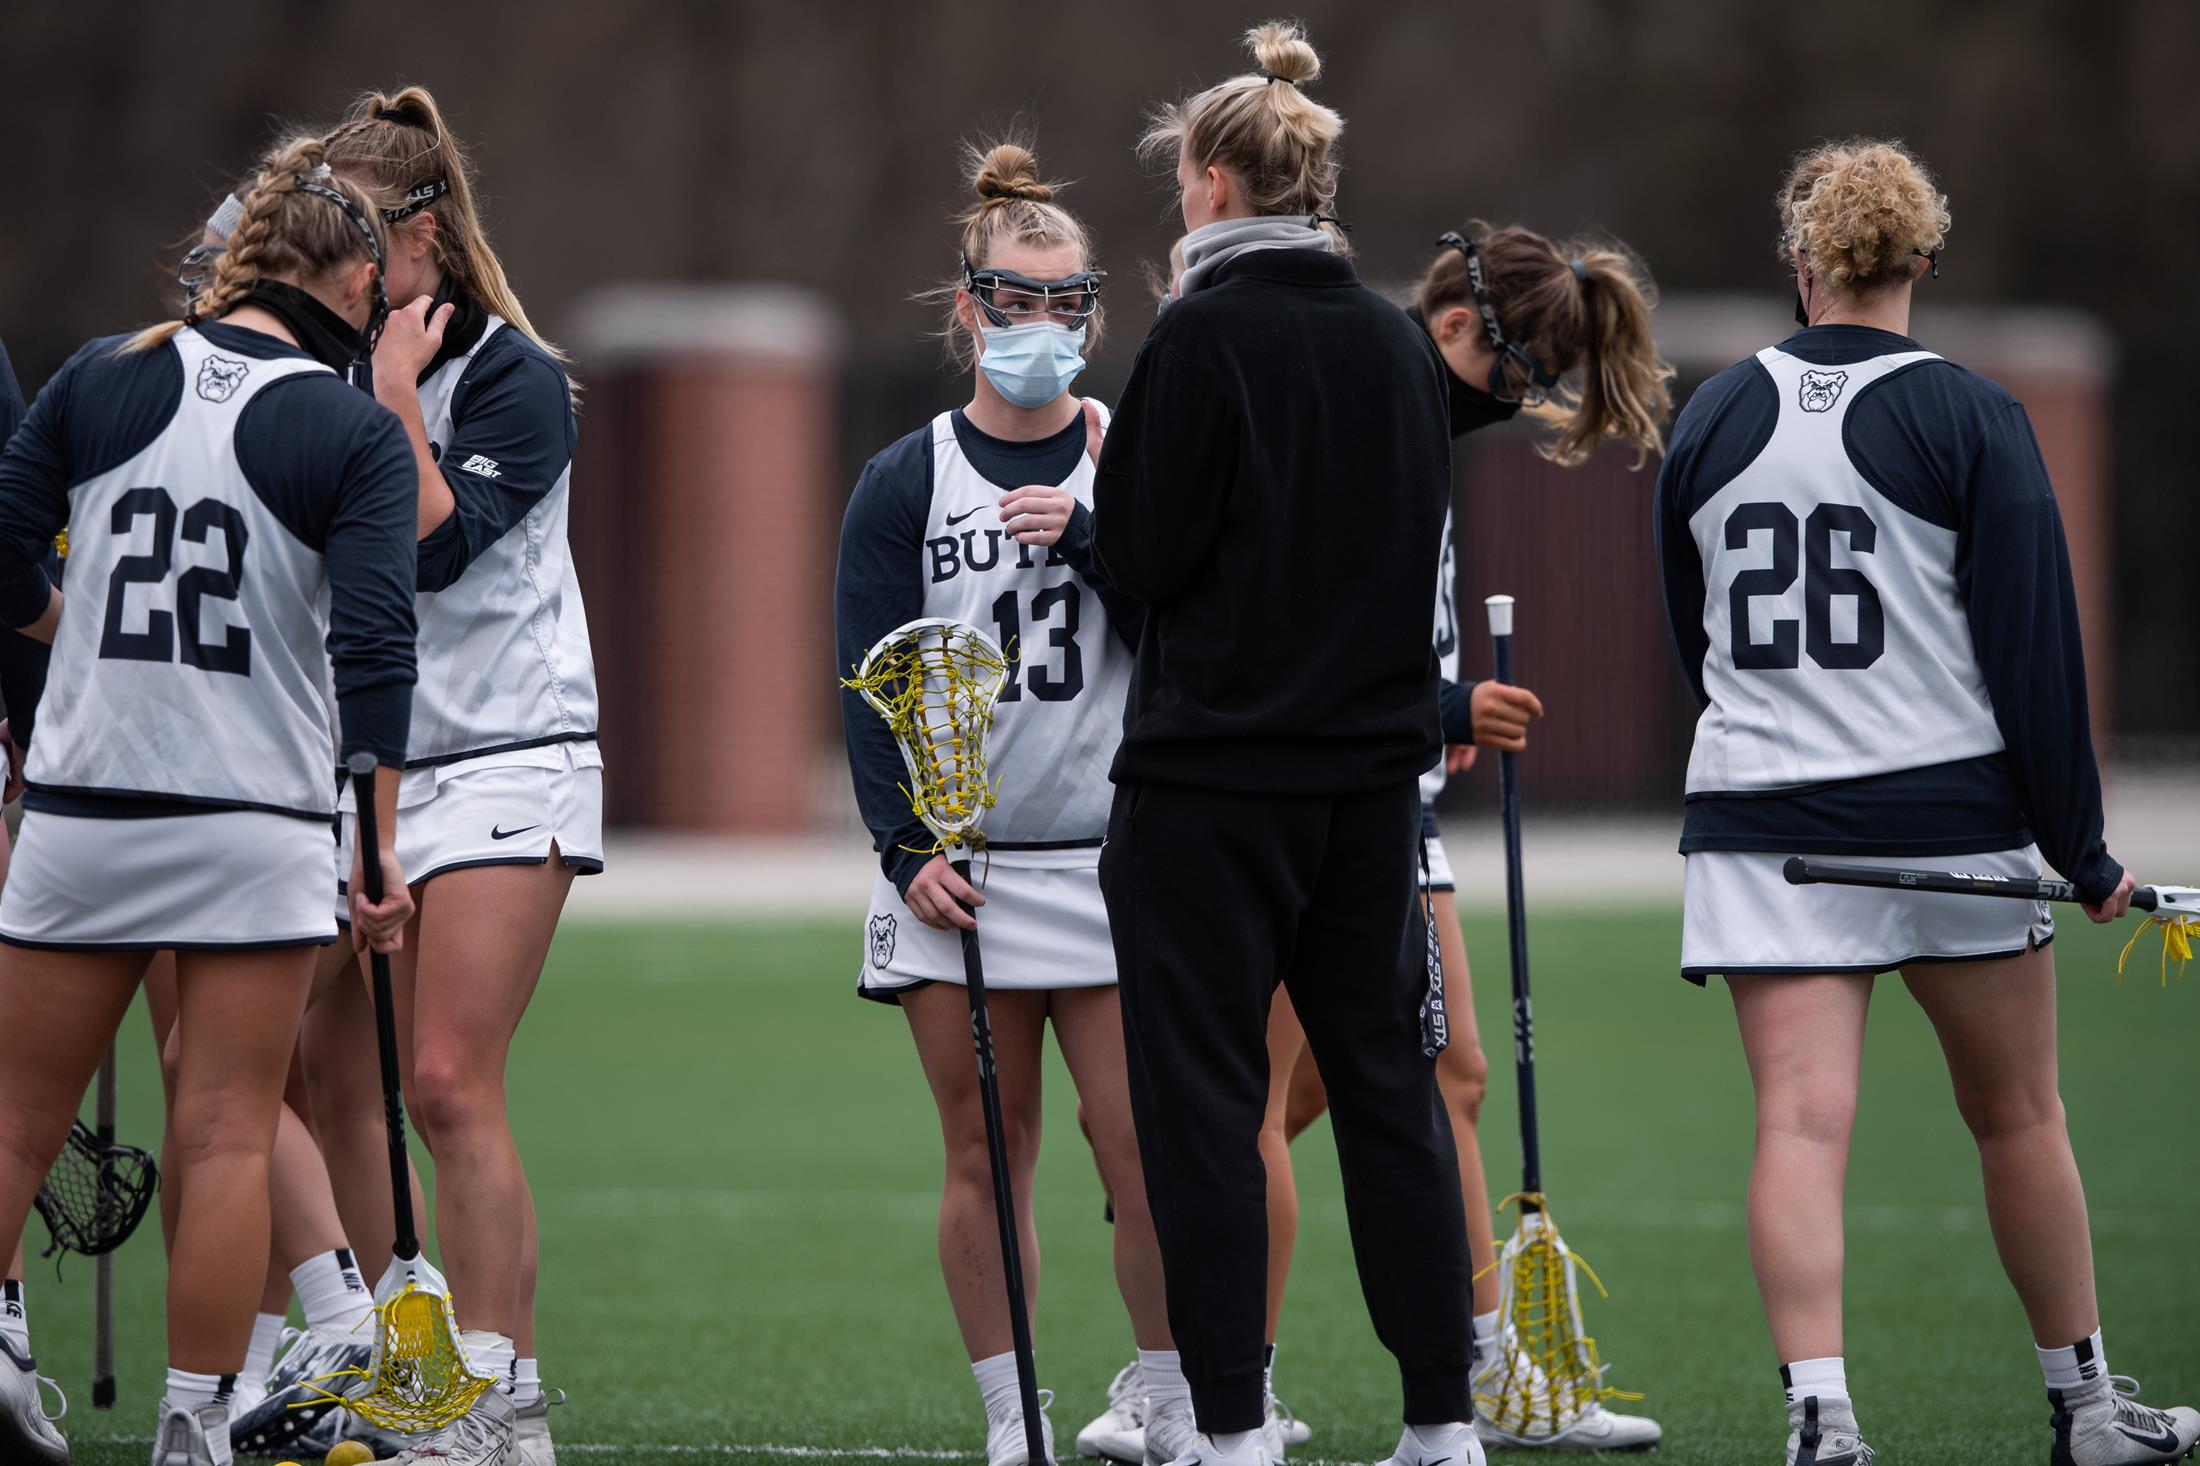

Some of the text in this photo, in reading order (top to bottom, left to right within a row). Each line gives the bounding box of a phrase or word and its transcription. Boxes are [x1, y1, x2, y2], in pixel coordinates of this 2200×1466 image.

[1467, 255, 1484, 293] STX
[1480, 304, 1504, 346] STX
[461, 460, 502, 478] EAST
[469, 454, 499, 469] BIG
[98, 486, 252, 678] 22
[1724, 501, 1885, 671] 26
[992, 580, 1084, 703] 13
[2037, 880, 2075, 900] STX
[1432, 1013, 1447, 1046] STX
